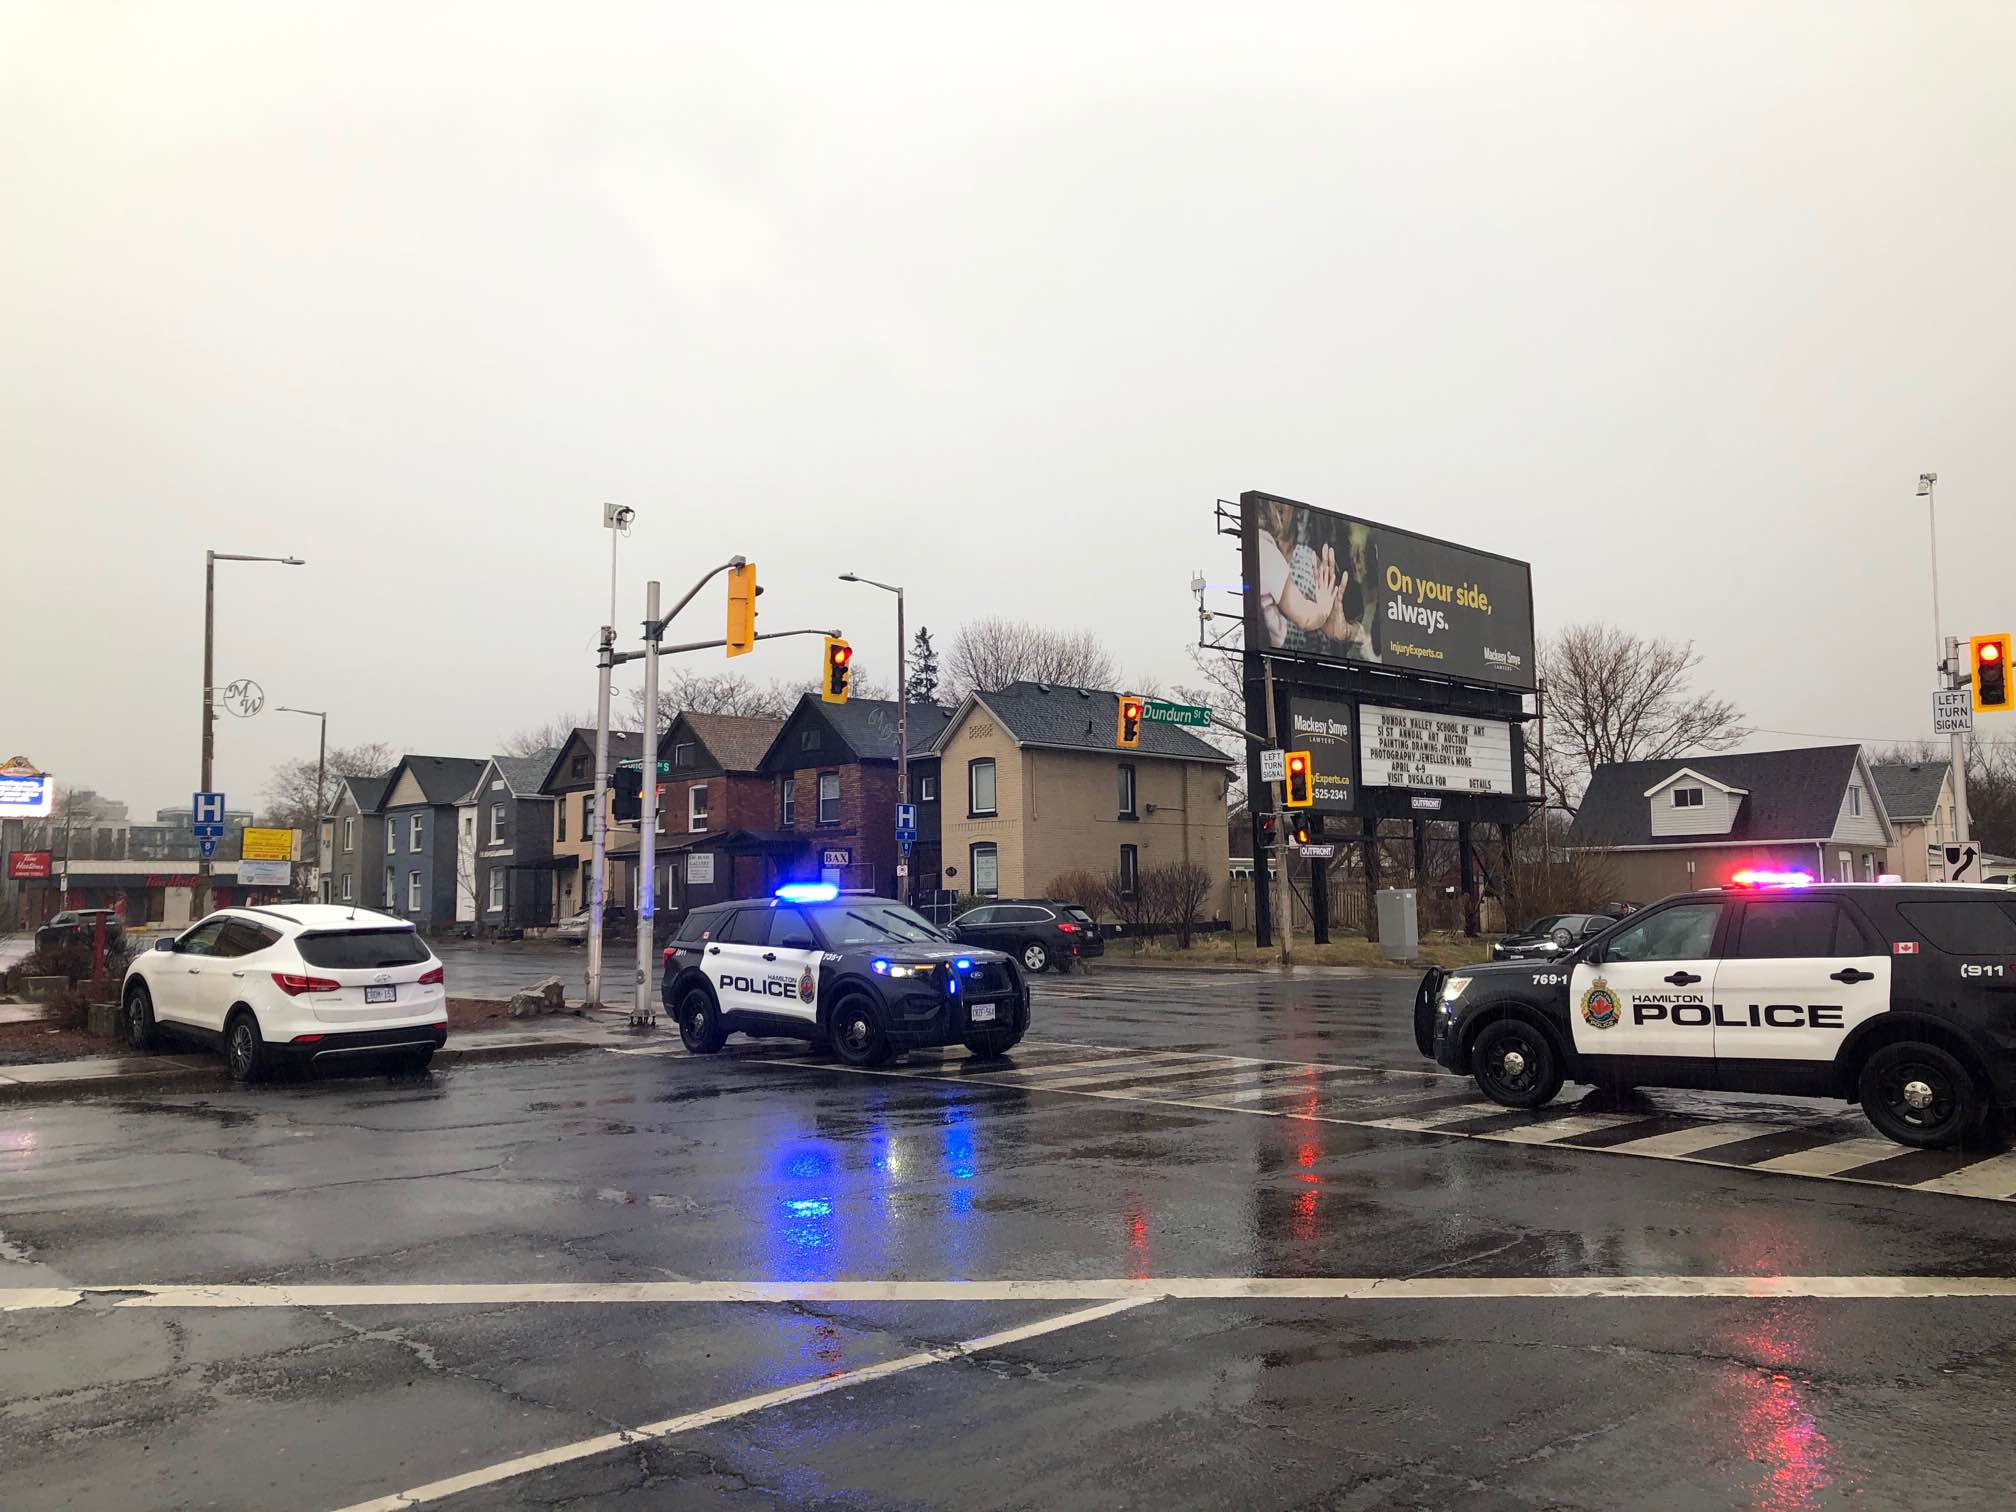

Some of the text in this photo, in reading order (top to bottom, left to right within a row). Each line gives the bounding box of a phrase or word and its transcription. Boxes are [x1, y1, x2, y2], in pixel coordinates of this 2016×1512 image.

[1386, 565, 1493, 616] On your side,
[1387, 595, 1449, 635] always.
[1390, 640, 1444, 660] InjuryExperts.ca
[1938, 694, 1966, 705] LEFT
[1142, 704, 1192, 723] Dundurn
[1203, 710, 1211, 724] S
[1938, 706, 1968, 717] TURN
[1294, 714, 1348, 737] Mackesy Smye
[1381, 715, 1485, 736] DUNDAS VALLEY SCHOOL OF ART
[1936, 719, 1971, 730] SIGNAL
[1399, 728, 1423, 741] ANNUAL
[1428, 731, 1439, 742] ART
[1443, 734, 1468, 745] AUCTION
[1263, 752, 1281, 761] LEFT
[1456, 757, 1472, 767] MORE
[1264, 761, 1283, 770] TURN
[1391, 762, 1426, 773] APRIL 4-9
[1263, 770, 1283, 779] SIGNAL
[1312, 772, 1350, 786] yExperts.ca
[1387, 772, 1492, 789] VISIT DVSA.CA FOR DETAILS
[1312, 788, 1348, 800] -525-2341
[198, 796, 221, 822] H
[1412, 799, 1440, 808] OUTFRONT
[898, 805, 914, 828] H
[1301, 847, 1332, 856] OUTFRONT
[825, 853, 848, 863] BAX
[1967, 965, 2004, 976] 911
[767, 974, 798, 984] HAMILTON
[720, 974, 797, 999] POLICE
[1632, 995, 1704, 1003] HAMILTON
[1632, 1004, 1845, 1029] POLICE
